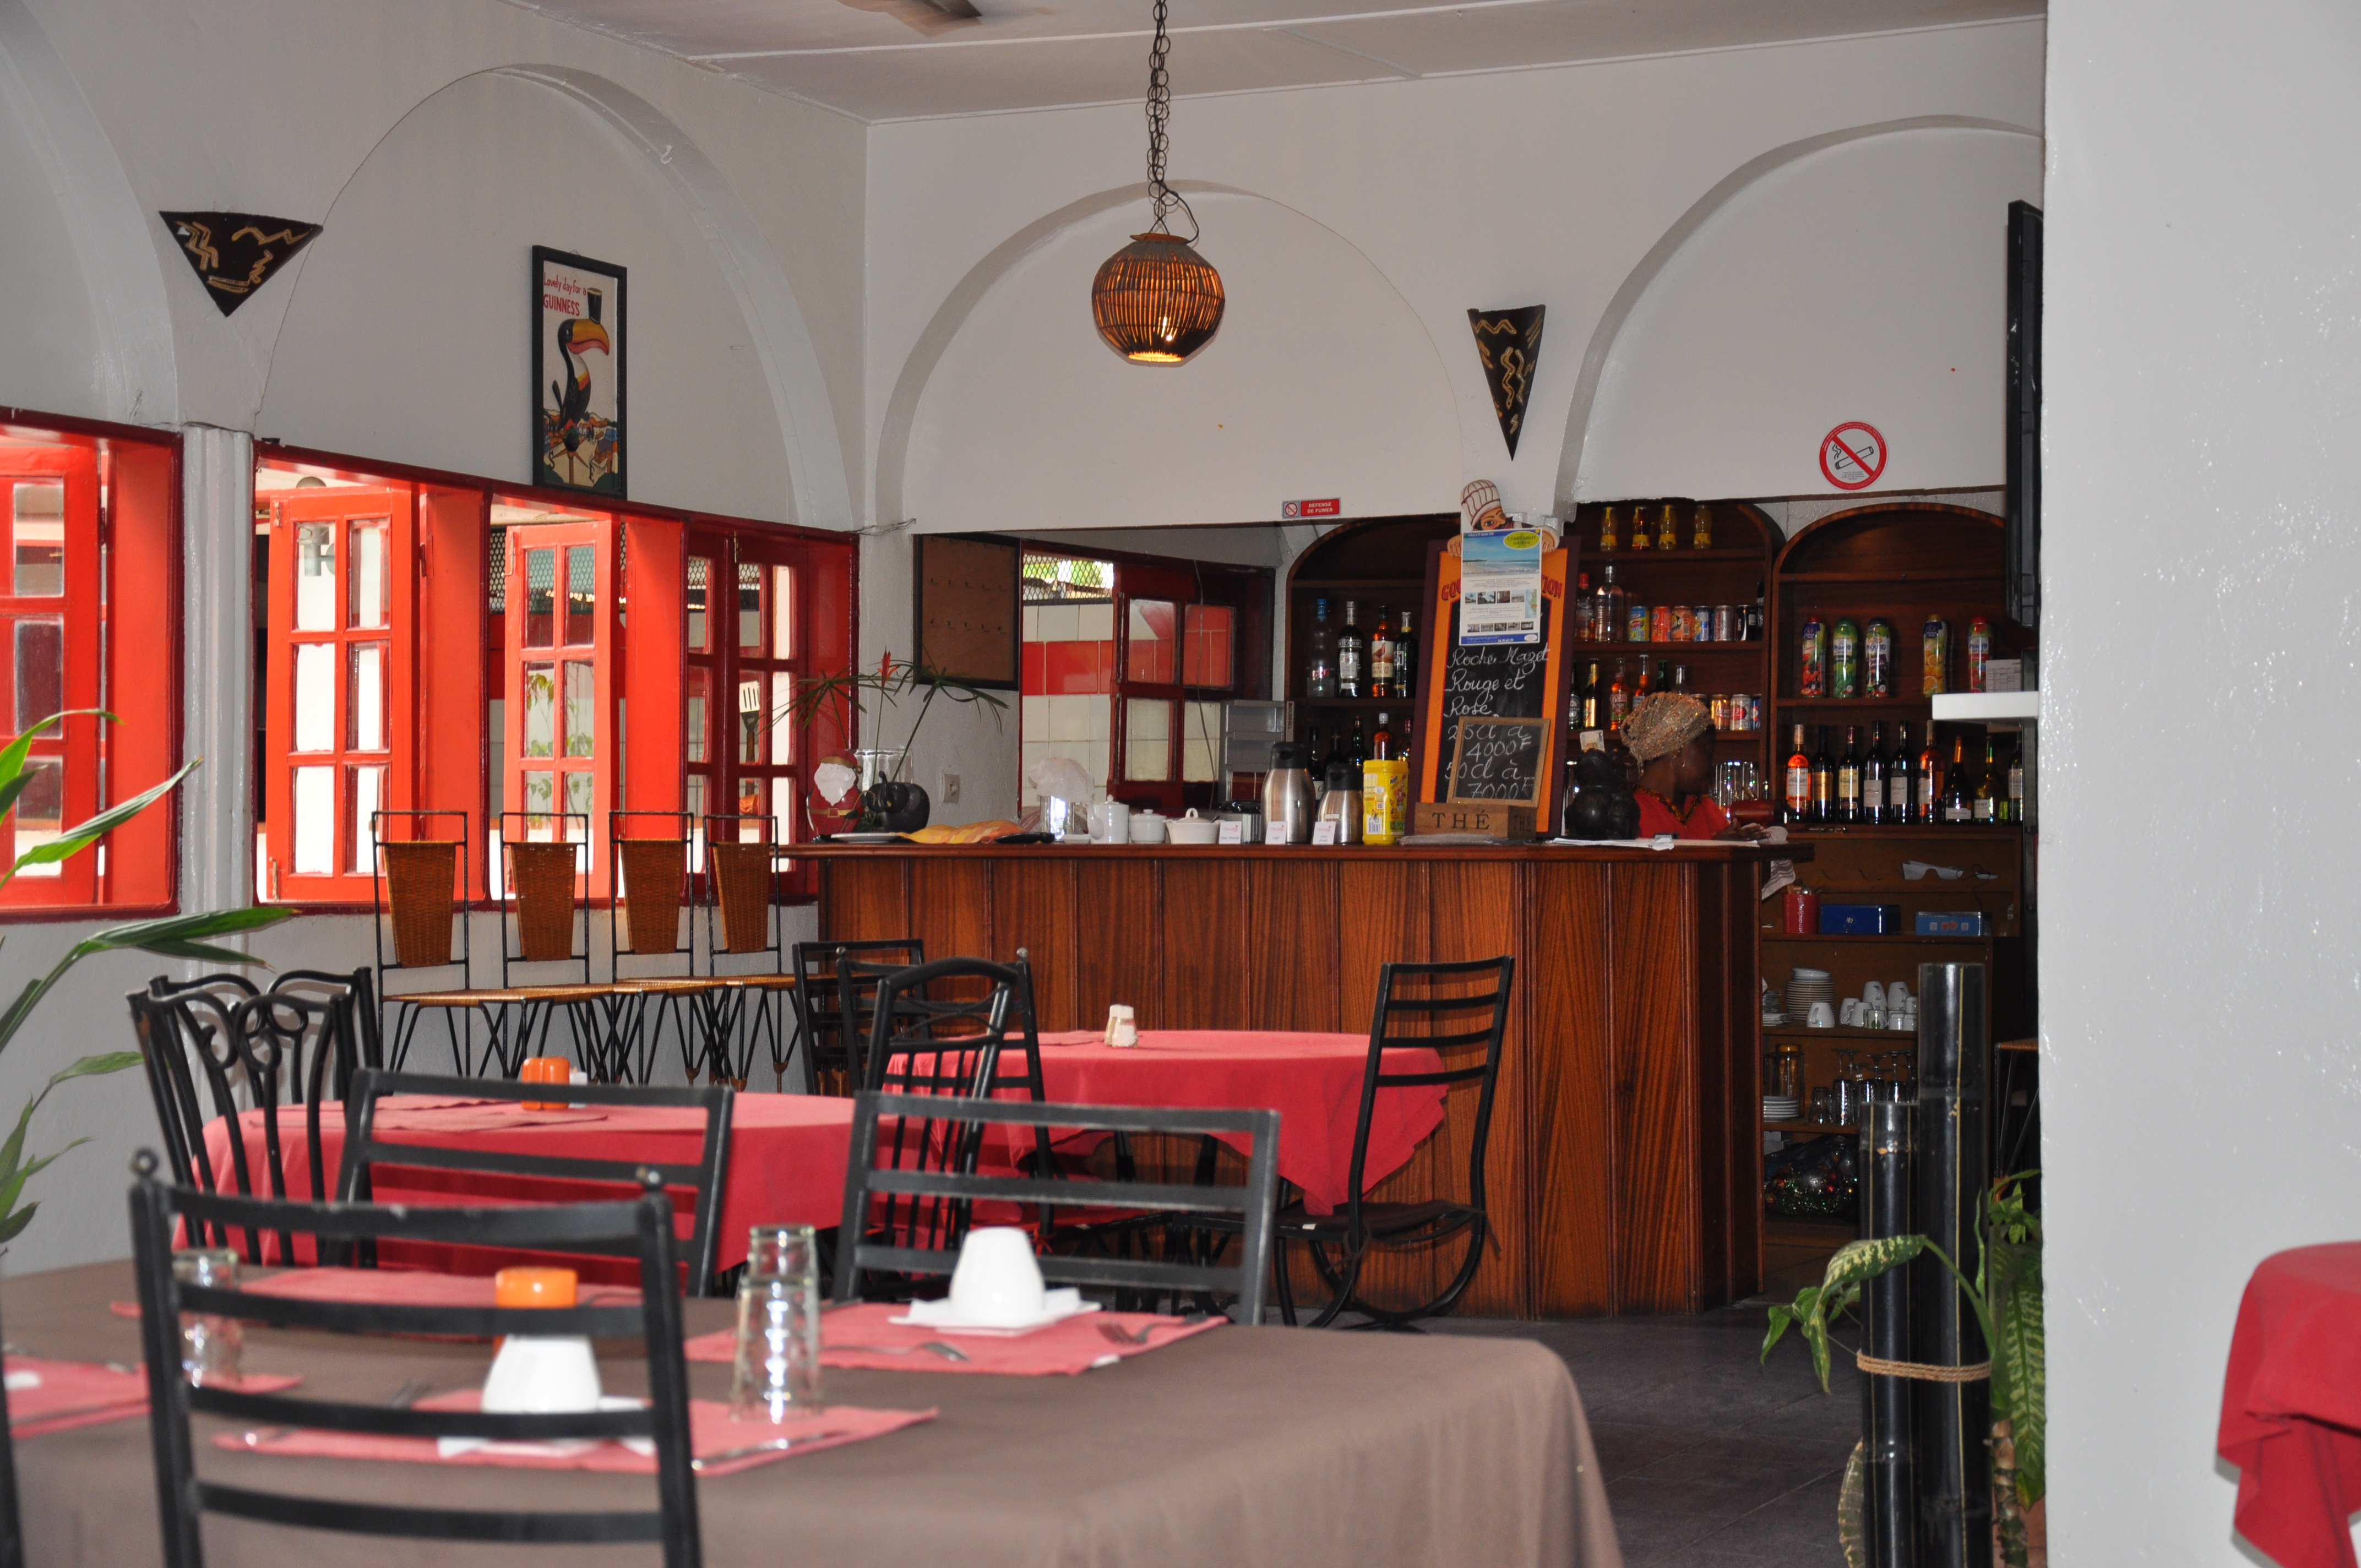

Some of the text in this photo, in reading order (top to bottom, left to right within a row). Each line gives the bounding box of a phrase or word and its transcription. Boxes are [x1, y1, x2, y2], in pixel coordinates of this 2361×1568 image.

[543, 272, 562, 292] Lovely
[563, 277, 573, 295] day
[543, 293, 580, 317] GUINNESS
[1444, 668, 1526, 706] Rouge et
[1432, 809, 1490, 830] THÉ
